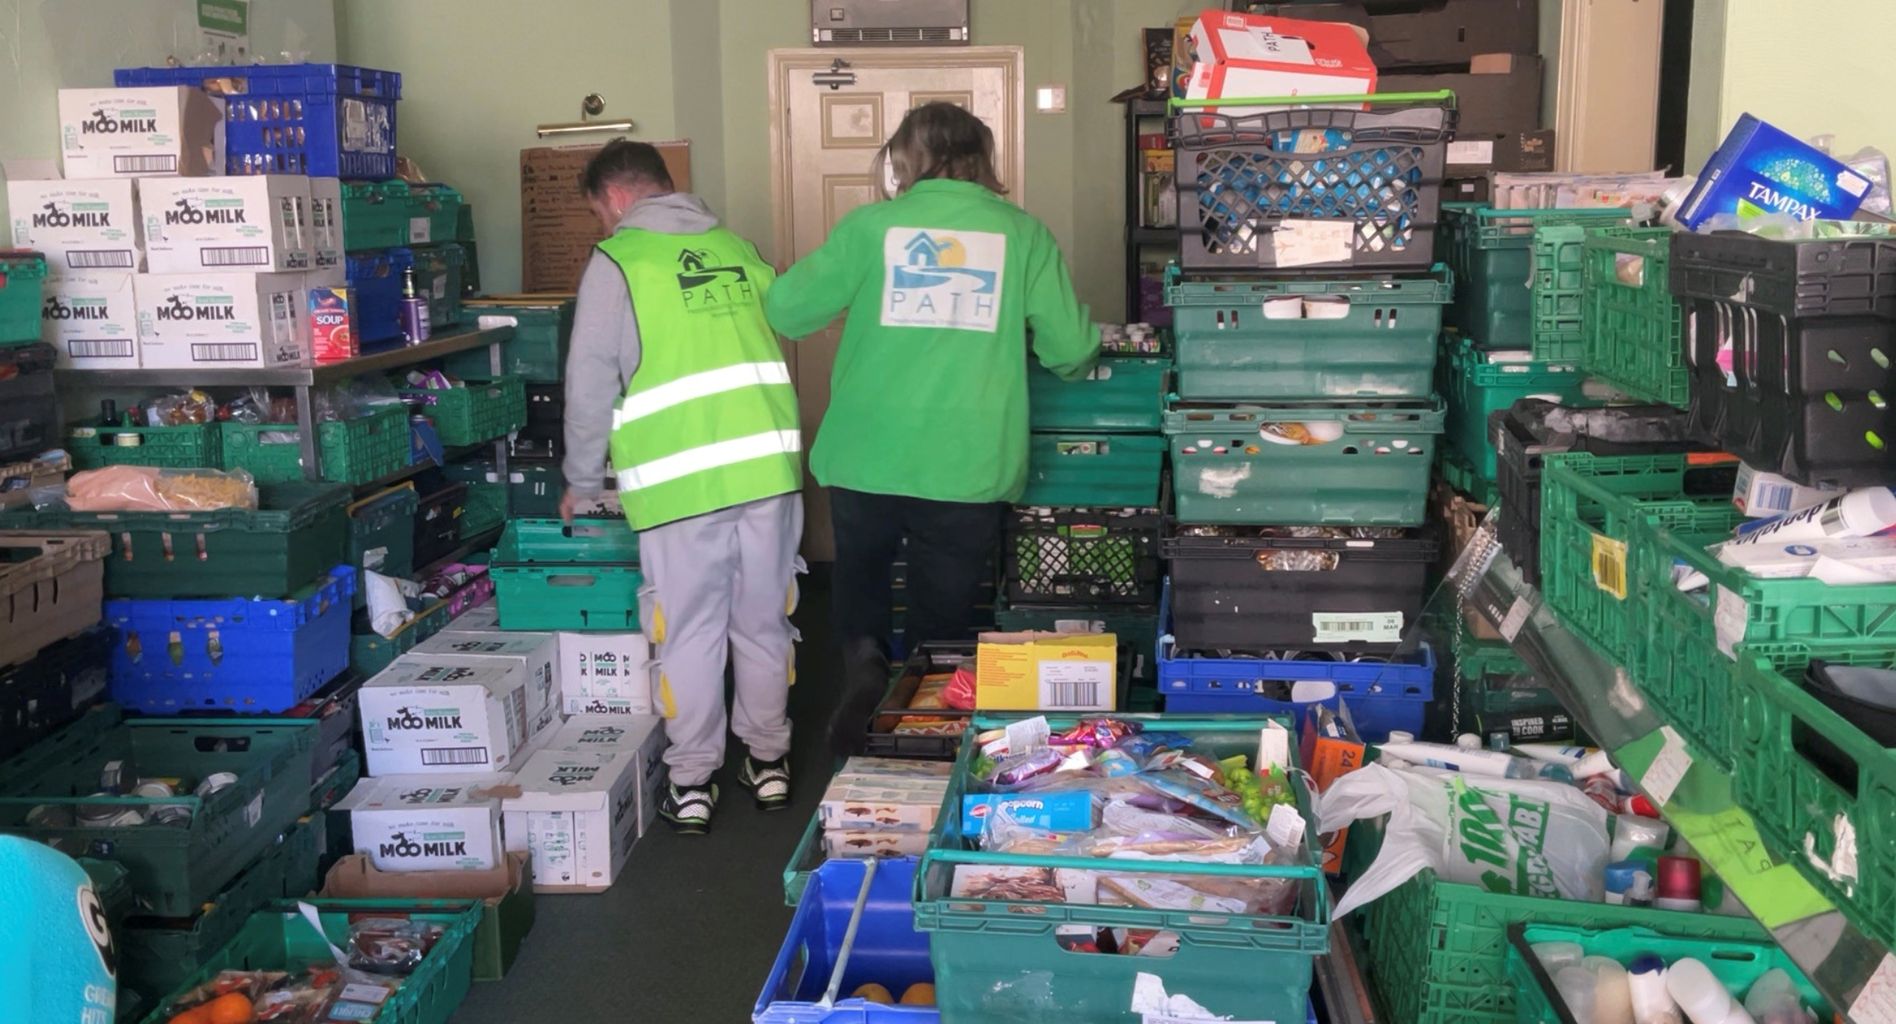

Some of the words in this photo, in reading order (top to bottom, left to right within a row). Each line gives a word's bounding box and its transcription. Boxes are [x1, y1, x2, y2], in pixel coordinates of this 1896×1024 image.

[1261, 31, 1280, 52] PATH
[82, 119, 118, 134] MOO
[120, 119, 157, 133] MILK
[1748, 181, 1822, 222] TAMPAX
[33, 212, 70, 228] MOO
[72, 212, 110, 227] MILK
[165, 209, 204, 225] MOO
[206, 209, 246, 224] MILK
[682, 283, 753, 308] PATH
[890, 290, 993, 318] PATH
[73, 306, 109, 320] MILK
[157, 305, 194, 321] MOO
[196, 305, 235, 320] MILK
[316, 315, 344, 325] SOUP
[594, 652, 616, 662] MOO
[595, 668, 617, 677] MILK
[585, 705, 608, 714] MOO
[609, 705, 631, 714] MILK
[387, 716, 423, 731] MOO
[425, 716, 463, 730] MILK
[1521, 725, 1544, 736] COOK
[380, 843, 421, 858] MOO
[423, 841, 467, 857] MILK
